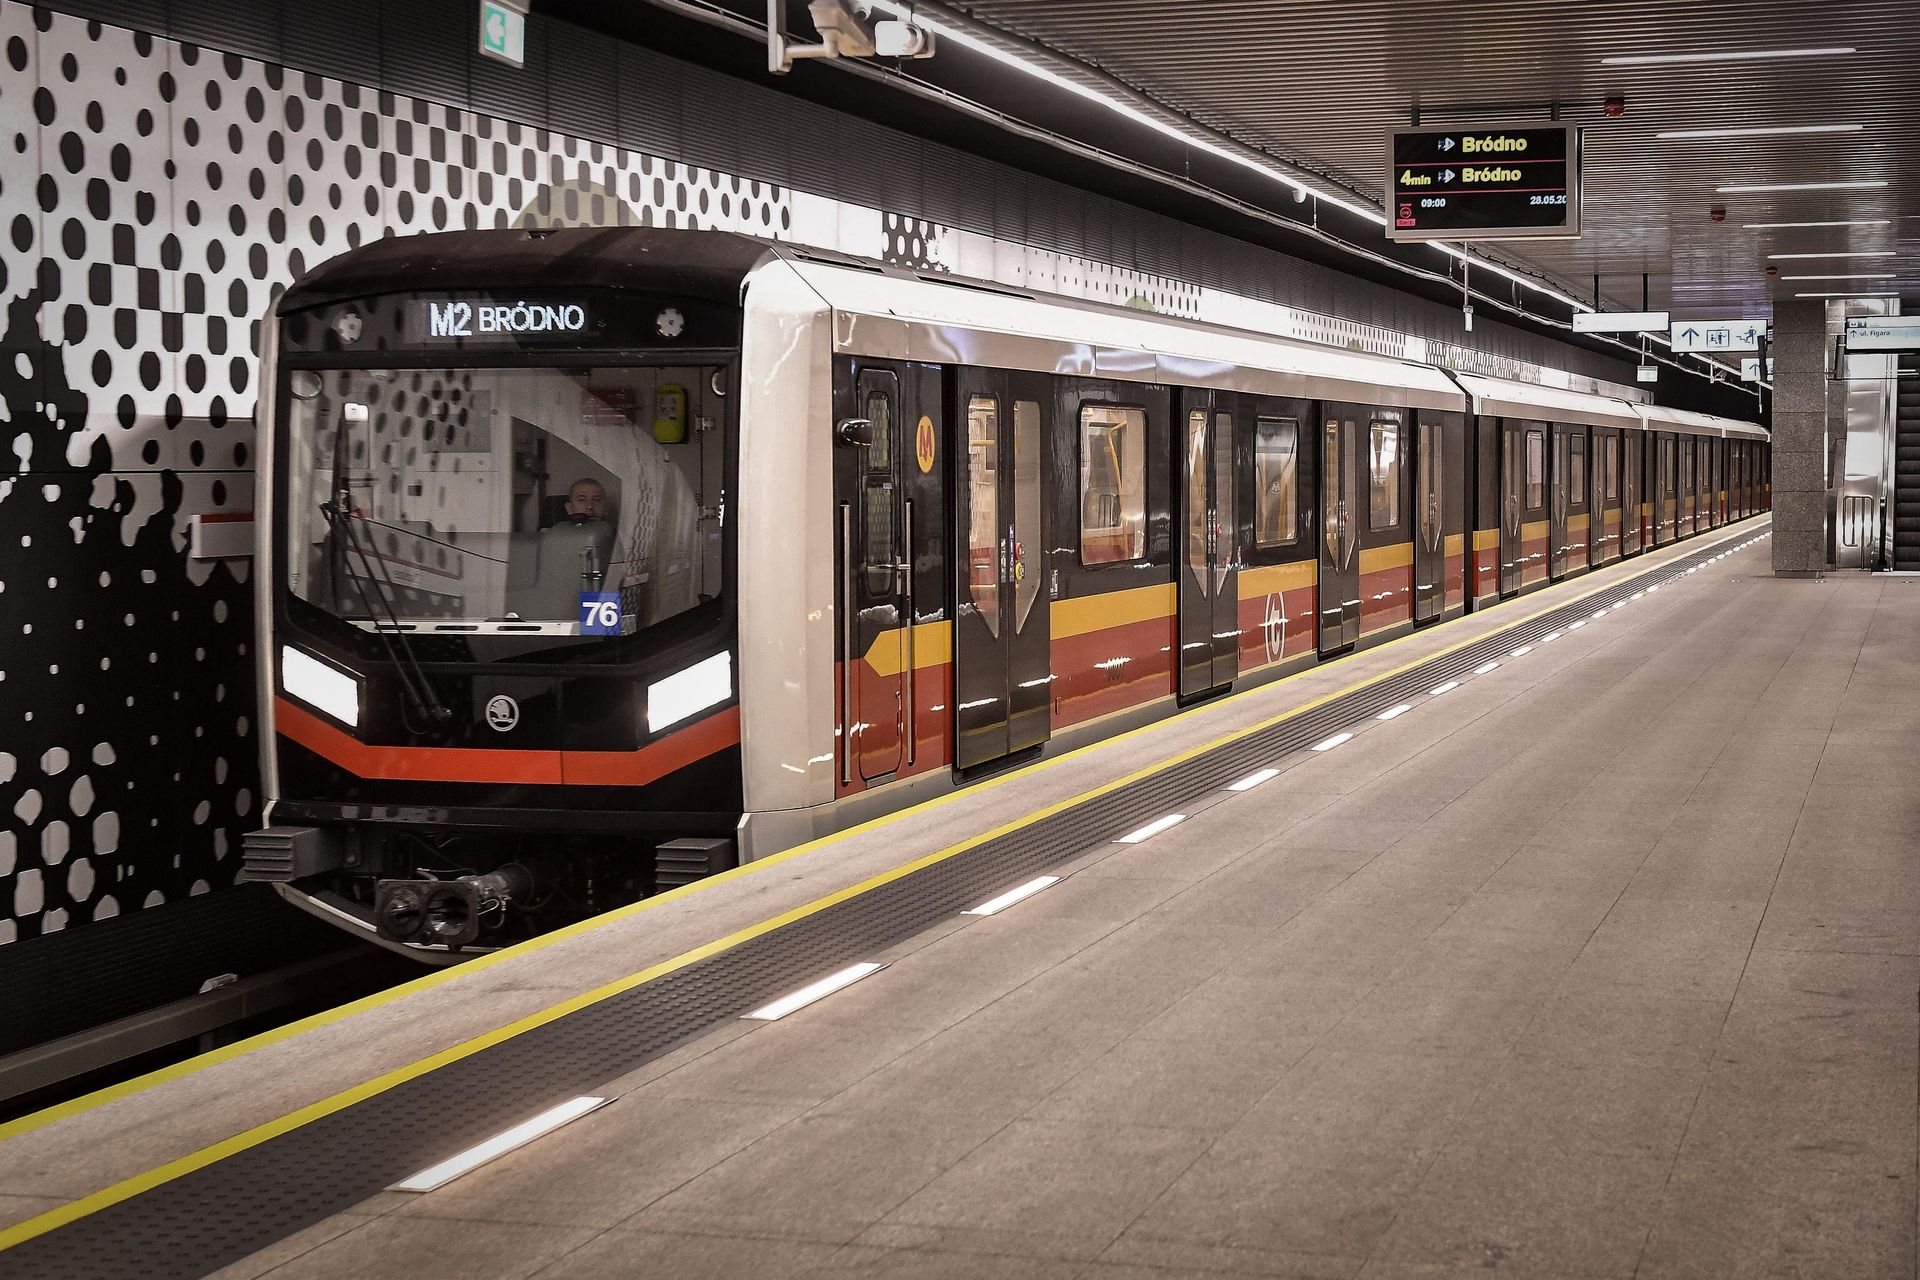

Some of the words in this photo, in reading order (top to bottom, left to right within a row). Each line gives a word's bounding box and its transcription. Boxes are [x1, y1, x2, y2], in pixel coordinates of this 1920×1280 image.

[1462, 136, 1528, 153] Bródno
[1400, 169, 1432, 186] 4min
[1462, 167, 1522, 182] Bródno
[1421, 198, 1446, 208] 09:00
[430, 302, 472, 336] M2
[478, 301, 585, 333] BRÓDNO
[920, 425, 933, 462] M
[582, 601, 619, 627] 76
